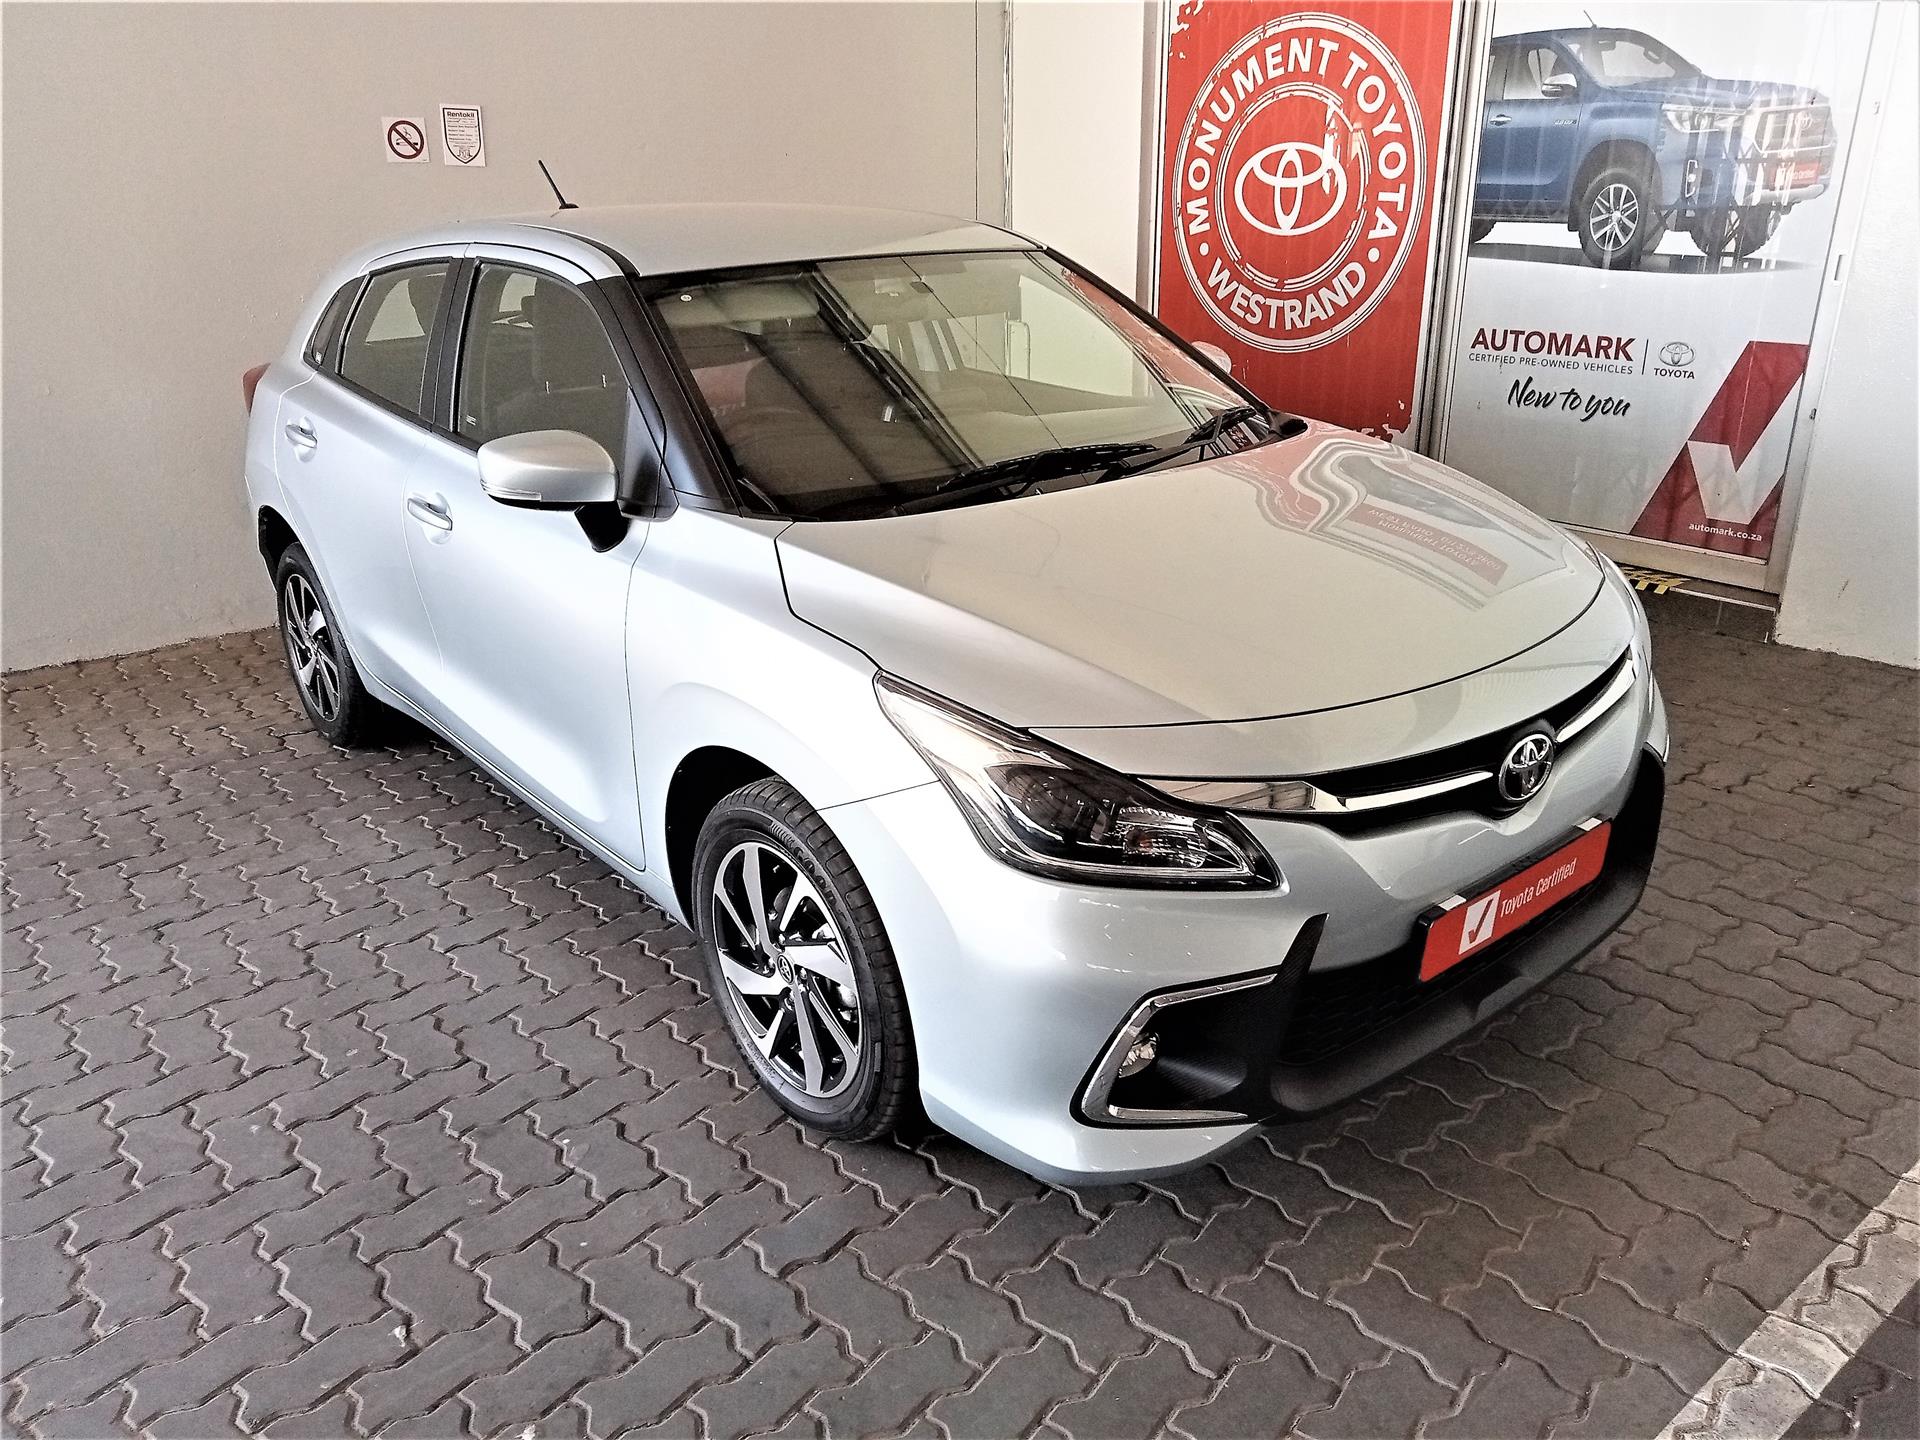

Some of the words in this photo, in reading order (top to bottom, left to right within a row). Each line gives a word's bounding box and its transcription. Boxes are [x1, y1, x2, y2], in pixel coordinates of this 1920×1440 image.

[1186, 37, 1340, 236] MONUMENT
[1341, 51, 1408, 240] TOYOTA
[1207, 257, 1366, 331] WESTRAND
[1468, 352, 1516, 365] CERTIFIED
[1519, 357, 1580, 370] PRE-OWNED
[1583, 363, 1634, 375] VEHICLES
[1470, 327, 1636, 362] AUTOMARK
[1653, 367, 1696, 380] TOYOTA
[1507, 376, 1557, 408] New
[1559, 387, 1582, 411] to
[1579, 396, 1632, 423] you
[1688, 523, 1763, 542] automark.co.za
[1500, 886, 1534, 918] Toyota
[1535, 857, 1577, 897] Certified
